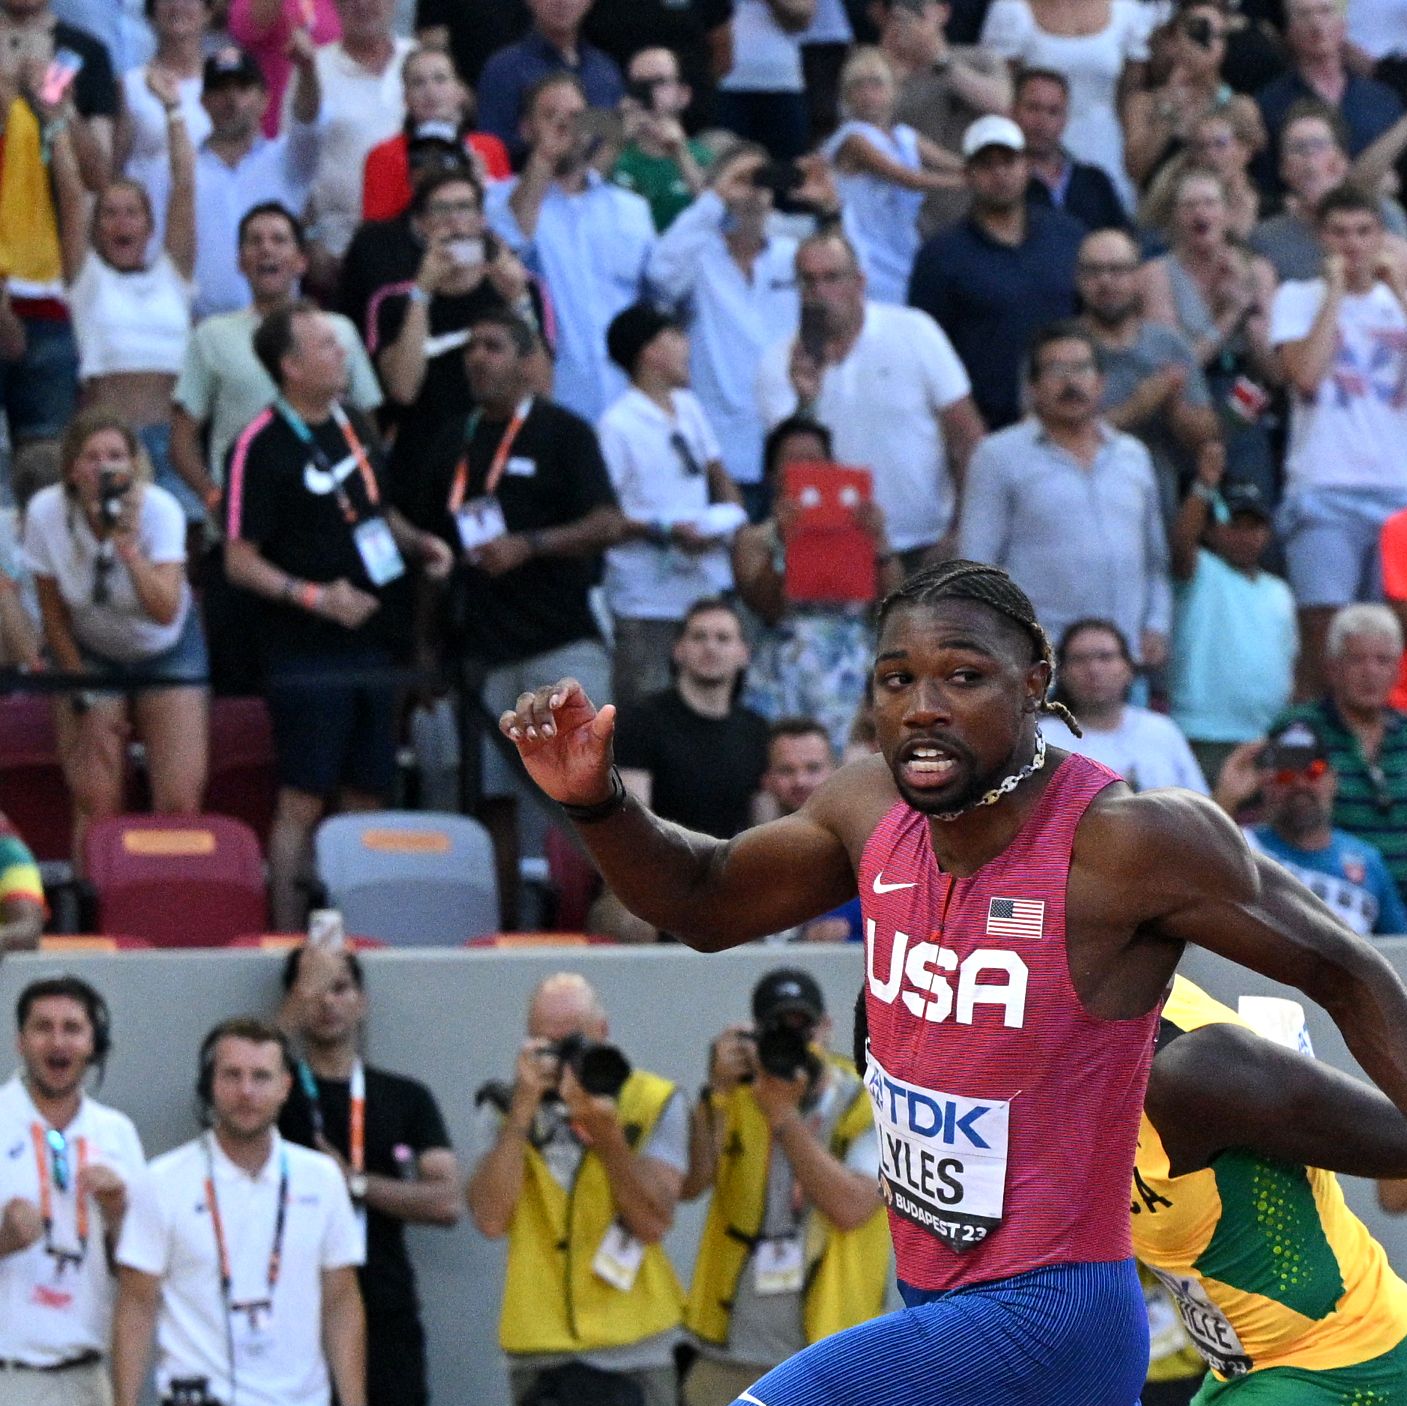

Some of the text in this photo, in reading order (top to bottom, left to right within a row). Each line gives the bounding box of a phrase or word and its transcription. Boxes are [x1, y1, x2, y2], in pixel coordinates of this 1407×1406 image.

[866, 917, 1029, 1029] USA
[883, 1076, 992, 1150] TDK
[879, 1122, 965, 1206] LYLES
[895, 1192, 988, 1242] BUDAPEST 23
